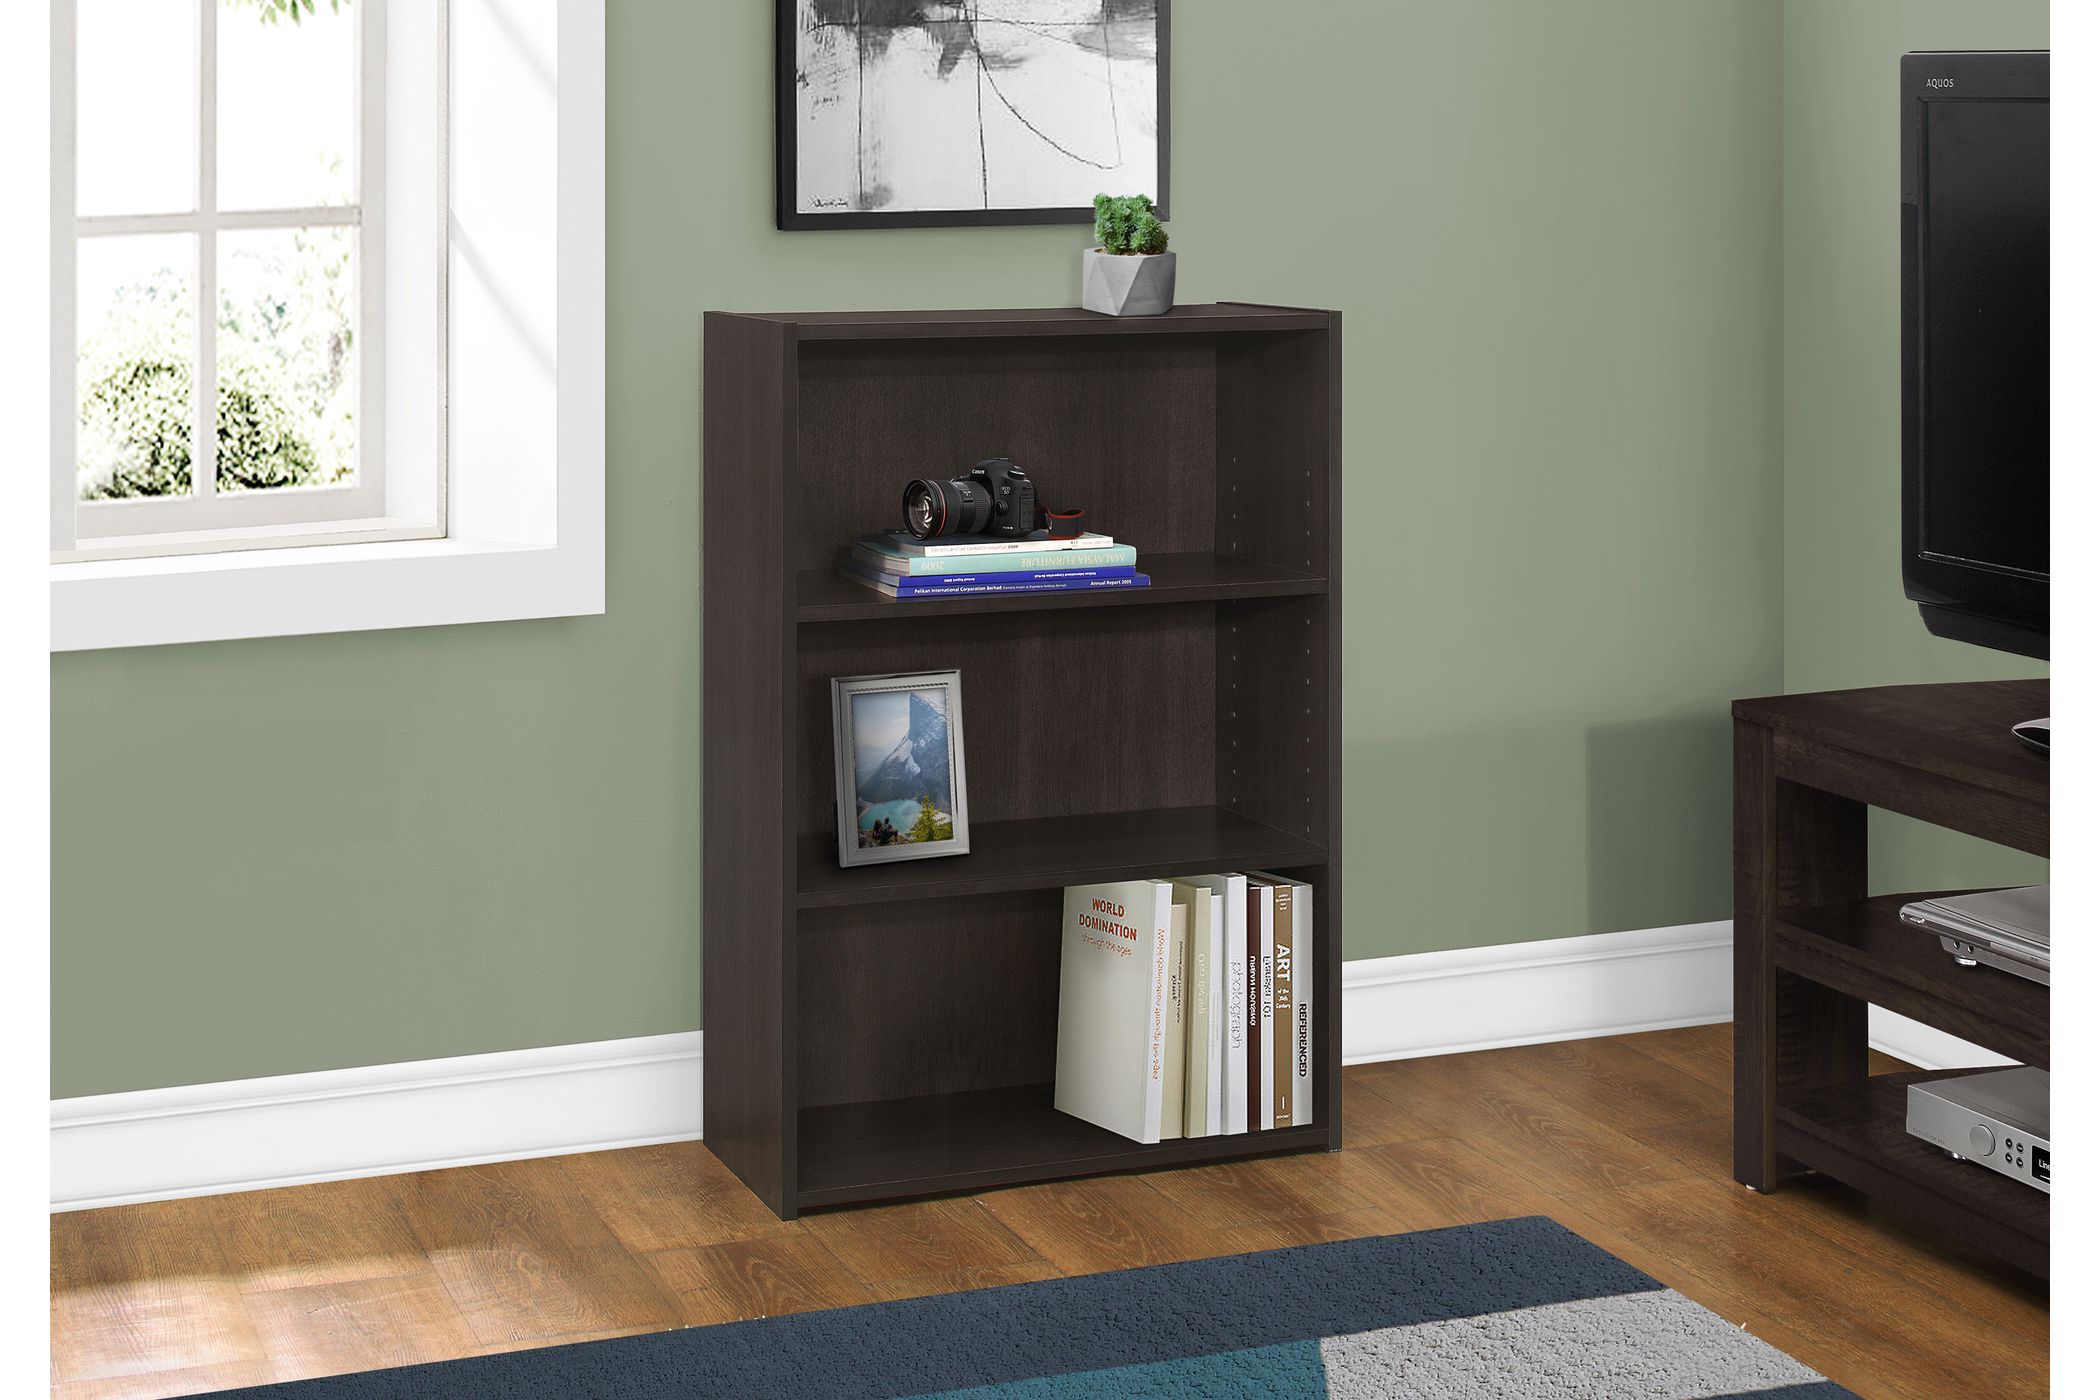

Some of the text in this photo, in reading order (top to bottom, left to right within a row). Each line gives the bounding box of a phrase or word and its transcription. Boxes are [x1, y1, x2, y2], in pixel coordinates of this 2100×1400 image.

[1926, 78, 1954, 90] AQUOS
[921, 553, 1126, 571] MALAYSIA FURNITURE 2009
[1092, 897, 1125, 918] WORLD
[1079, 913, 1138, 941] DOMINATION
[1277, 944, 1291, 982] ART
[1230, 962, 1243, 1049] photograph
[1298, 1003, 1307, 1077] REFERENCED
